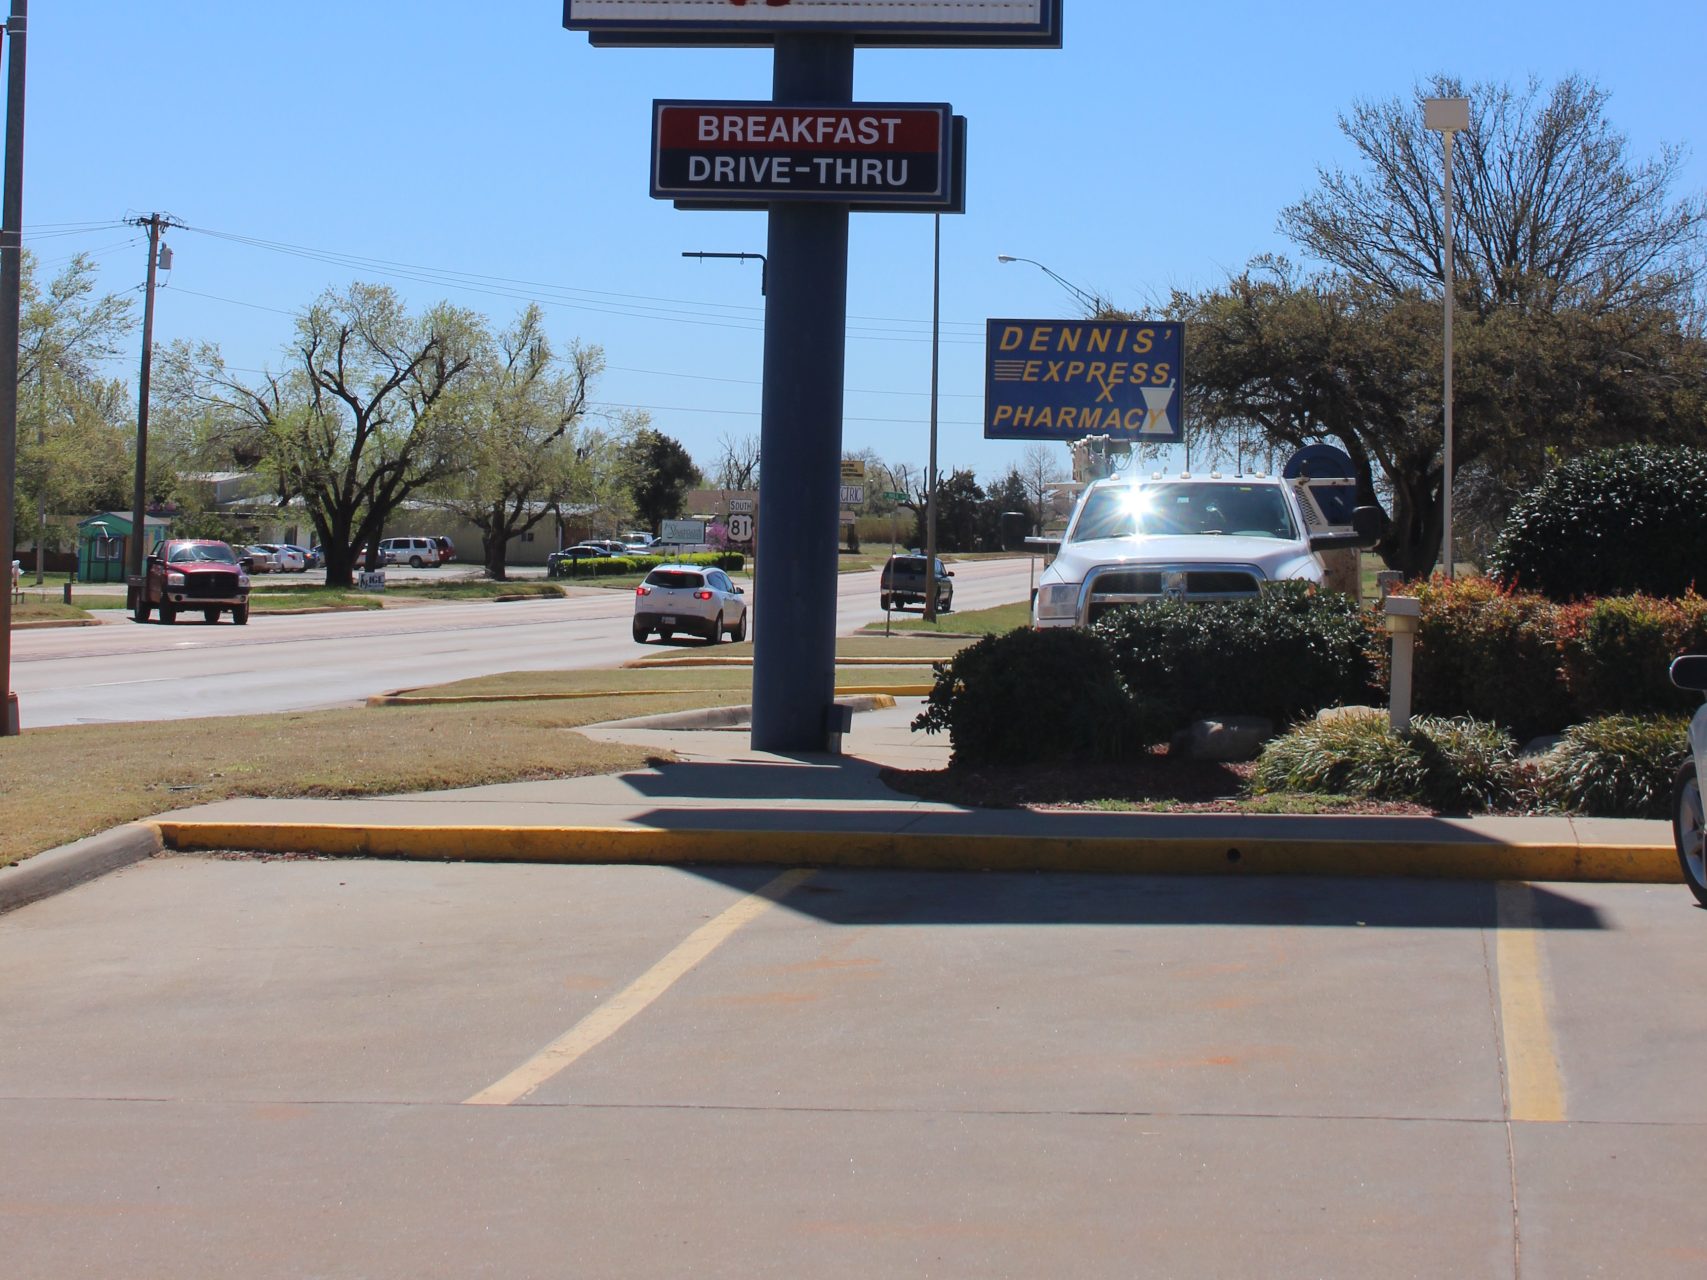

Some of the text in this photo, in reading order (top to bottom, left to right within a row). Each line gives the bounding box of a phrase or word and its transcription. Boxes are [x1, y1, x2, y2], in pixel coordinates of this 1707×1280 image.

[697, 115, 902, 145] BREAKFAST
[688, 155, 908, 186] DRIVE-THRU
[999, 326, 1172, 353] DENNIS'
[1022, 360, 1171, 384] EXPRESS
[992, 404, 1167, 430] PHARMACY
[730, 502, 752, 511] SOUTH
[731, 519, 748, 537] 81
